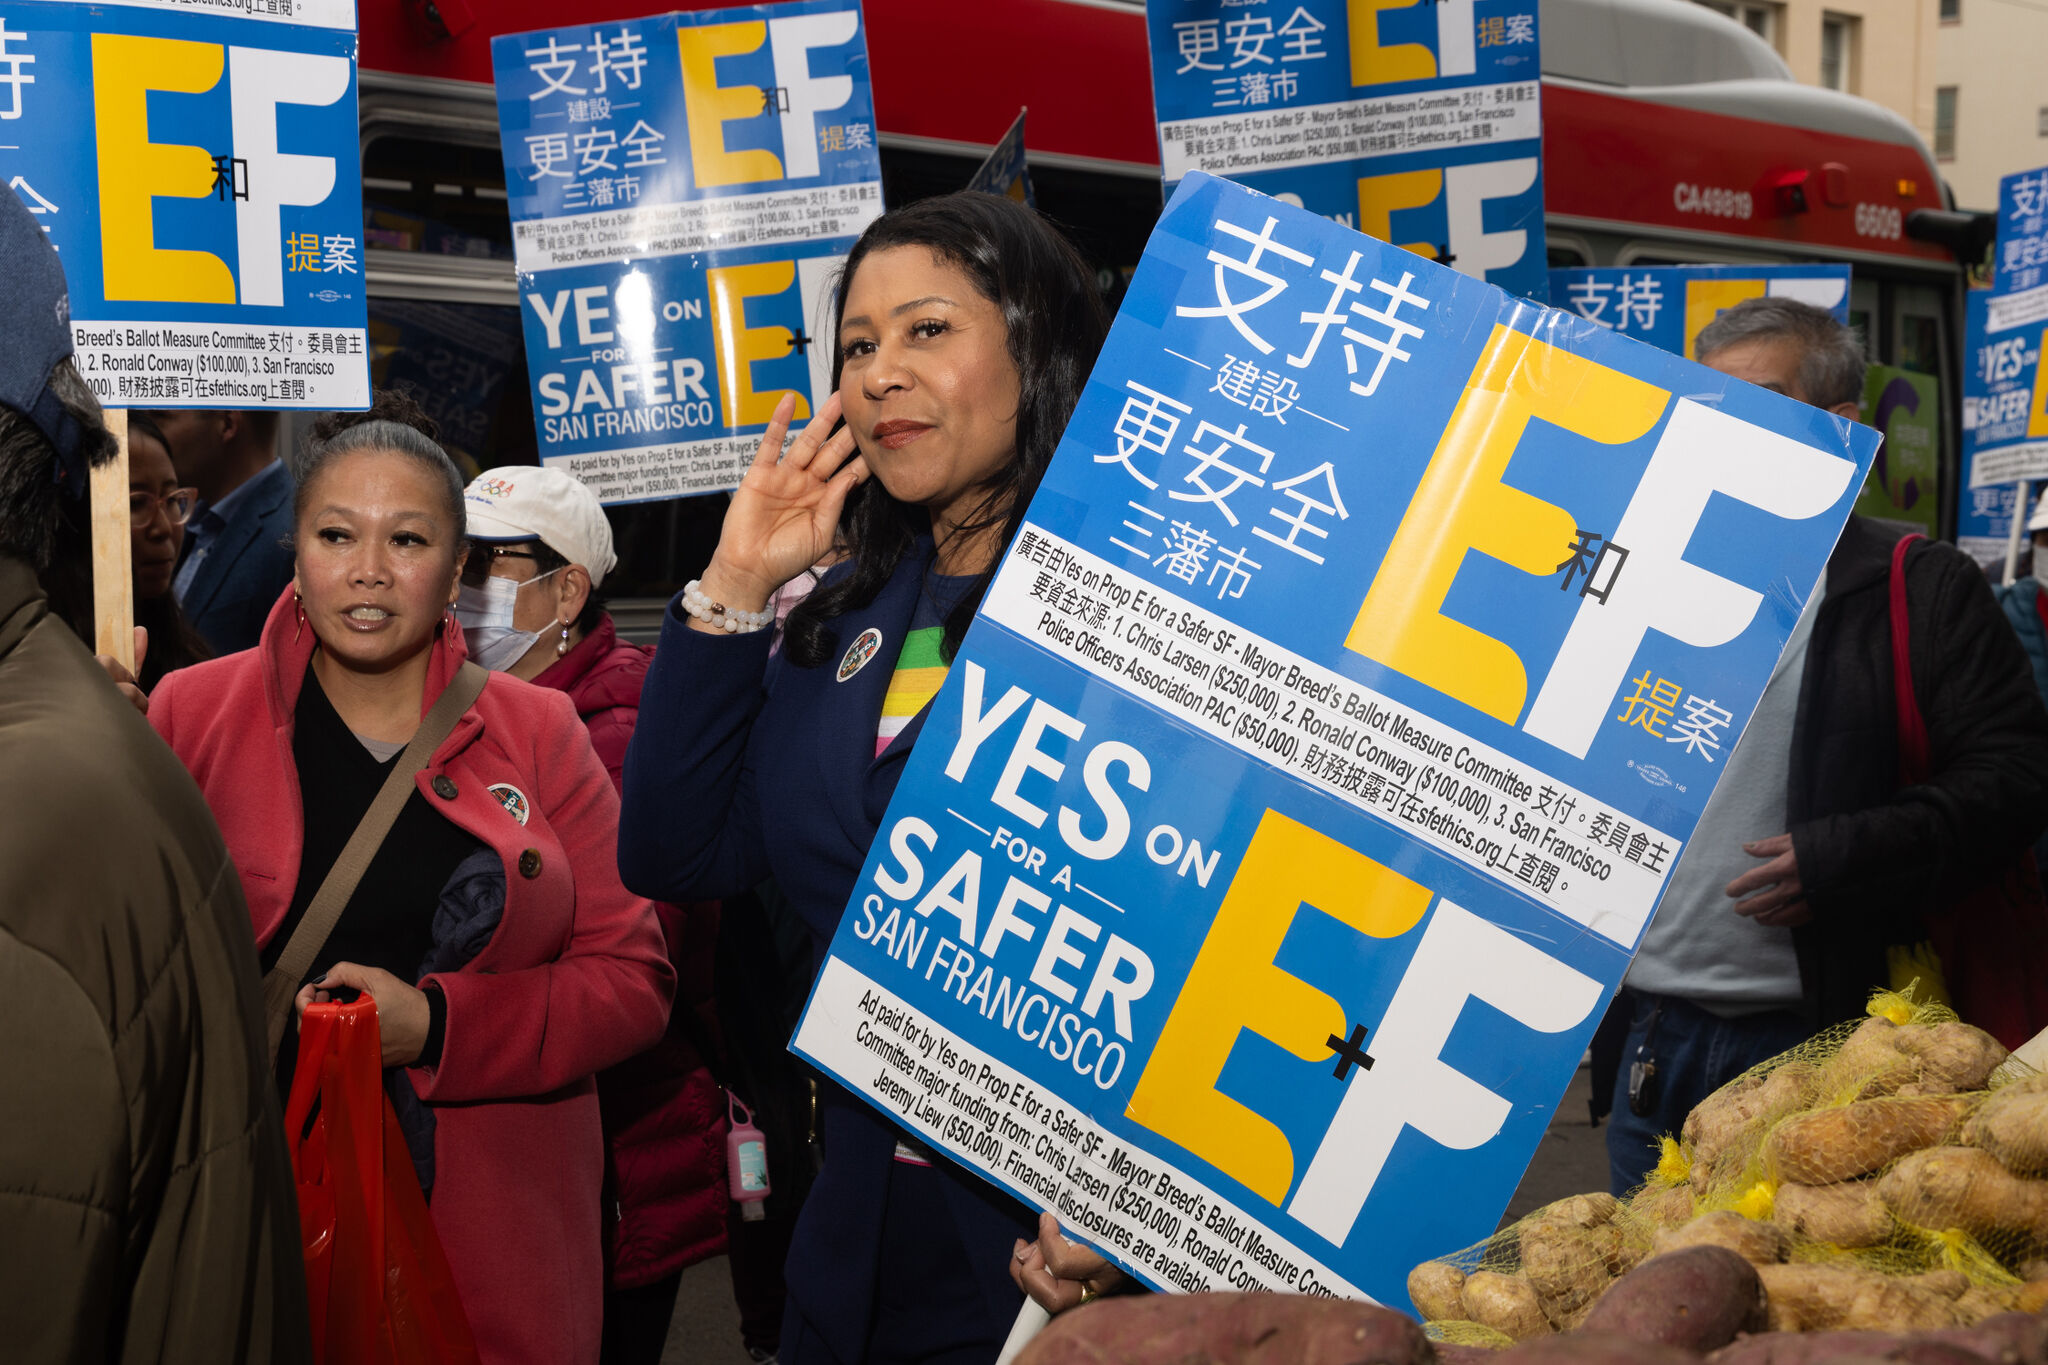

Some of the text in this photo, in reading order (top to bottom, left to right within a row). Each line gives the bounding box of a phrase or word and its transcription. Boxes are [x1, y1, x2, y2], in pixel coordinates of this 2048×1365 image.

[1172, 6, 1328, 75] 更安全
[1477, 13, 1535, 49] 提案
[524, 27, 648, 101] 支持
[1211, 68, 1300, 108] 三藩市
[567, 97, 612, 124] 建設
[677, 10, 859, 189] E 和 F
[524, 119, 667, 182] 更安全
[820, 123, 873, 154] 提案
[91, 33, 350, 307] E 和 F
[562, 174, 641, 209] 三藩市
[1855, 202, 1902, 240] 6609
[286, 232, 358, 274] 提案
[528, 275, 702, 349] YE ON
[1176, 216, 1430, 397] 支持
[1568, 273, 1664, 330] 支持
[88, 354, 98, 370] 2.
[102, 354, 144, 372] Ronald
[148, 355, 193, 376] Conway
[196, 356, 250, 376] ($100,000),
[252, 360, 261, 374] 3.
[263, 360, 282, 374] San
[284, 358, 334, 376] Francisco
[126, 330, 159, 348] Ballot
[163, 331, 209, 348] Measure
[212, 332, 265, 350] Committee
[592, 349, 625, 364] FOR
[1984, 336, 2026, 384] YES
[539, 358, 710, 417] SAFER
[1209, 353, 1300, 425] 建設
[544, 401, 714, 443] SAN FRANCISCO
[598, 486, 625, 499] Jeremy
[626, 483, 644, 495] Liew
[682, 474, 714, 490] Financial
[618, 470, 638, 483] major
[640, 466, 668, 480] funding
[670, 463, 689, 476] from:
[690, 460, 710, 473] Chris
[1094, 380, 1349, 565] 更安全
[1109, 501, 1262, 600] 三藩市
[1341, 322, 1861, 816] E 和 F
[1037, 611, 1074, 646] Police
[1075, 631, 1124, 672] Officers
[1123, 658, 1202, 712] Association
[1202, 696, 1236, 727] PAC
[1232, 712, 1299, 765] ($50,000).
[1082, 571, 1099, 590] on
[1098, 573, 1131, 608] Prop
[1131, 590, 1147, 612] E
[1144, 597, 1167, 621] for
[1165, 612, 1176, 628] a
[1177, 613, 1214, 645] Safer
[1213, 630, 1236, 653] SF
[1240, 643, 1286, 680] Mayor
[1343, 693, 1390, 732] Ballot
[1389, 715, 1452, 762] Measure
[1455, 747, 1532, 802] Committee
[1617, 670, 1733, 762] 提案
[944, 660, 1221, 888] YES ON
[1113, 616, 1124, 637] 1.
[1127, 623, 1163, 656] Chris
[1163, 641, 1210, 680] Larsen
[1209, 664, 1280, 719] ($250,000),
[1281, 700, 1296, 724] 2.
[1297, 707, 1357, 751] Ronald
[1356, 736, 1417, 785] Conway
[1415, 765, 1491, 824] ($100,000),
[1494, 804, 1507, 828] 3.
[1510, 812, 1540, 844] San
[1539, 827, 1611, 881] Francisco
[991, 826, 1071, 892] FOR A
[874, 817, 1154, 1042] SAFER
[854, 894, 1125, 1089] SAN FRANCISCO
[858, 989, 880, 1016] Ad
[874, 1005, 905, 1032] paid
[901, 1016, 921, 1043] for
[919, 1027, 937, 1058] by
[937, 1038, 958, 1069] Yes
[958, 1059, 976, 1080] on
[1118, 802, 1436, 1216] E
[1284, 893, 1609, 1321] F
[976, 1064, 1010, 1103] Prop
[1007, 1083, 1025, 1115] E
[1021, 1090, 1043, 1118] for
[1041, 1108, 1052, 1126] a
[1044, 1109, 1084, 1150] Safer
[856, 1019, 915, 1076] Committee
[914, 1052, 951, 1098] major
[948, 1082, 1000, 1133] funding
[999, 1112, 1035, 1155] from:
[1035, 1134, 1067, 1172] Chris
[1065, 1156, 1110, 1201] Larsen
[1108, 1181, 1181, 1248] ($250,000),
[1181, 1227, 1232, 1279] Ronald
[1228, 1260, 1274, 1293] Conw
[873, 1068, 916, 1115] Jeremy
[914, 1089, 945, 1129] Liew
[942, 1114, 1003, 1169] ($50,000).
[1004, 1150, 1062, 1203] Financial
[1058, 1189, 1133, 1249] disclosures
[1132, 1239, 1156, 1264] are
[1082, 1131, 1103, 1157] SF
[1107, 1147, 1157, 1202] Mayor
[1204, 1205, 1247, 1258] Ballot
[1236, 1230, 1298, 1284] Measure
